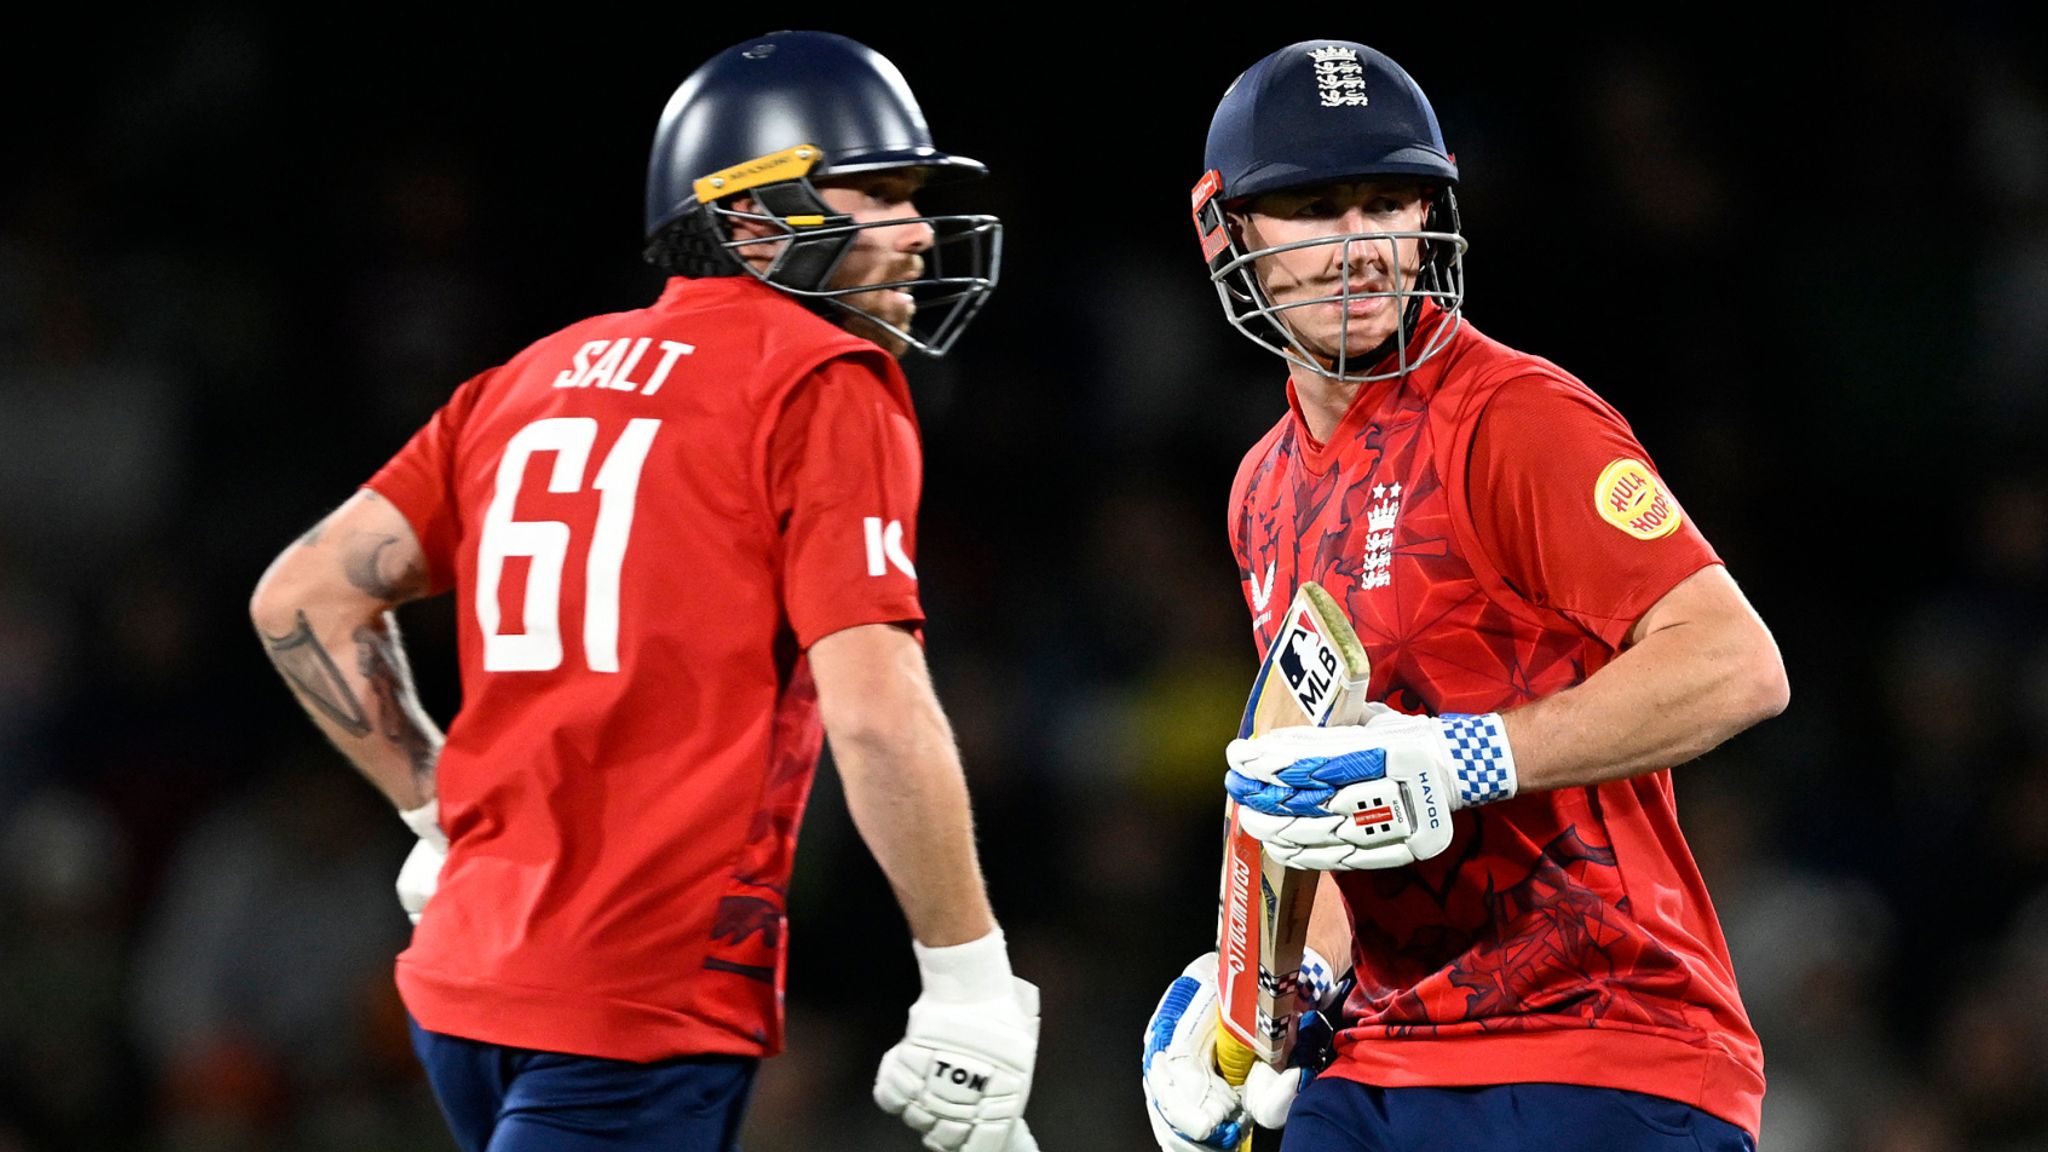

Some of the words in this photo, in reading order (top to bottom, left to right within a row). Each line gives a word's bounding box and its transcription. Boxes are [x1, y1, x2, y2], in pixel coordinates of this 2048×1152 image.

[553, 337, 696, 396] SALT
[1610, 471, 1647, 512] HULA
[475, 416, 662, 673] 61
[1298, 646, 1337, 716] MLB
[1418, 771, 1440, 829] HAVOC
